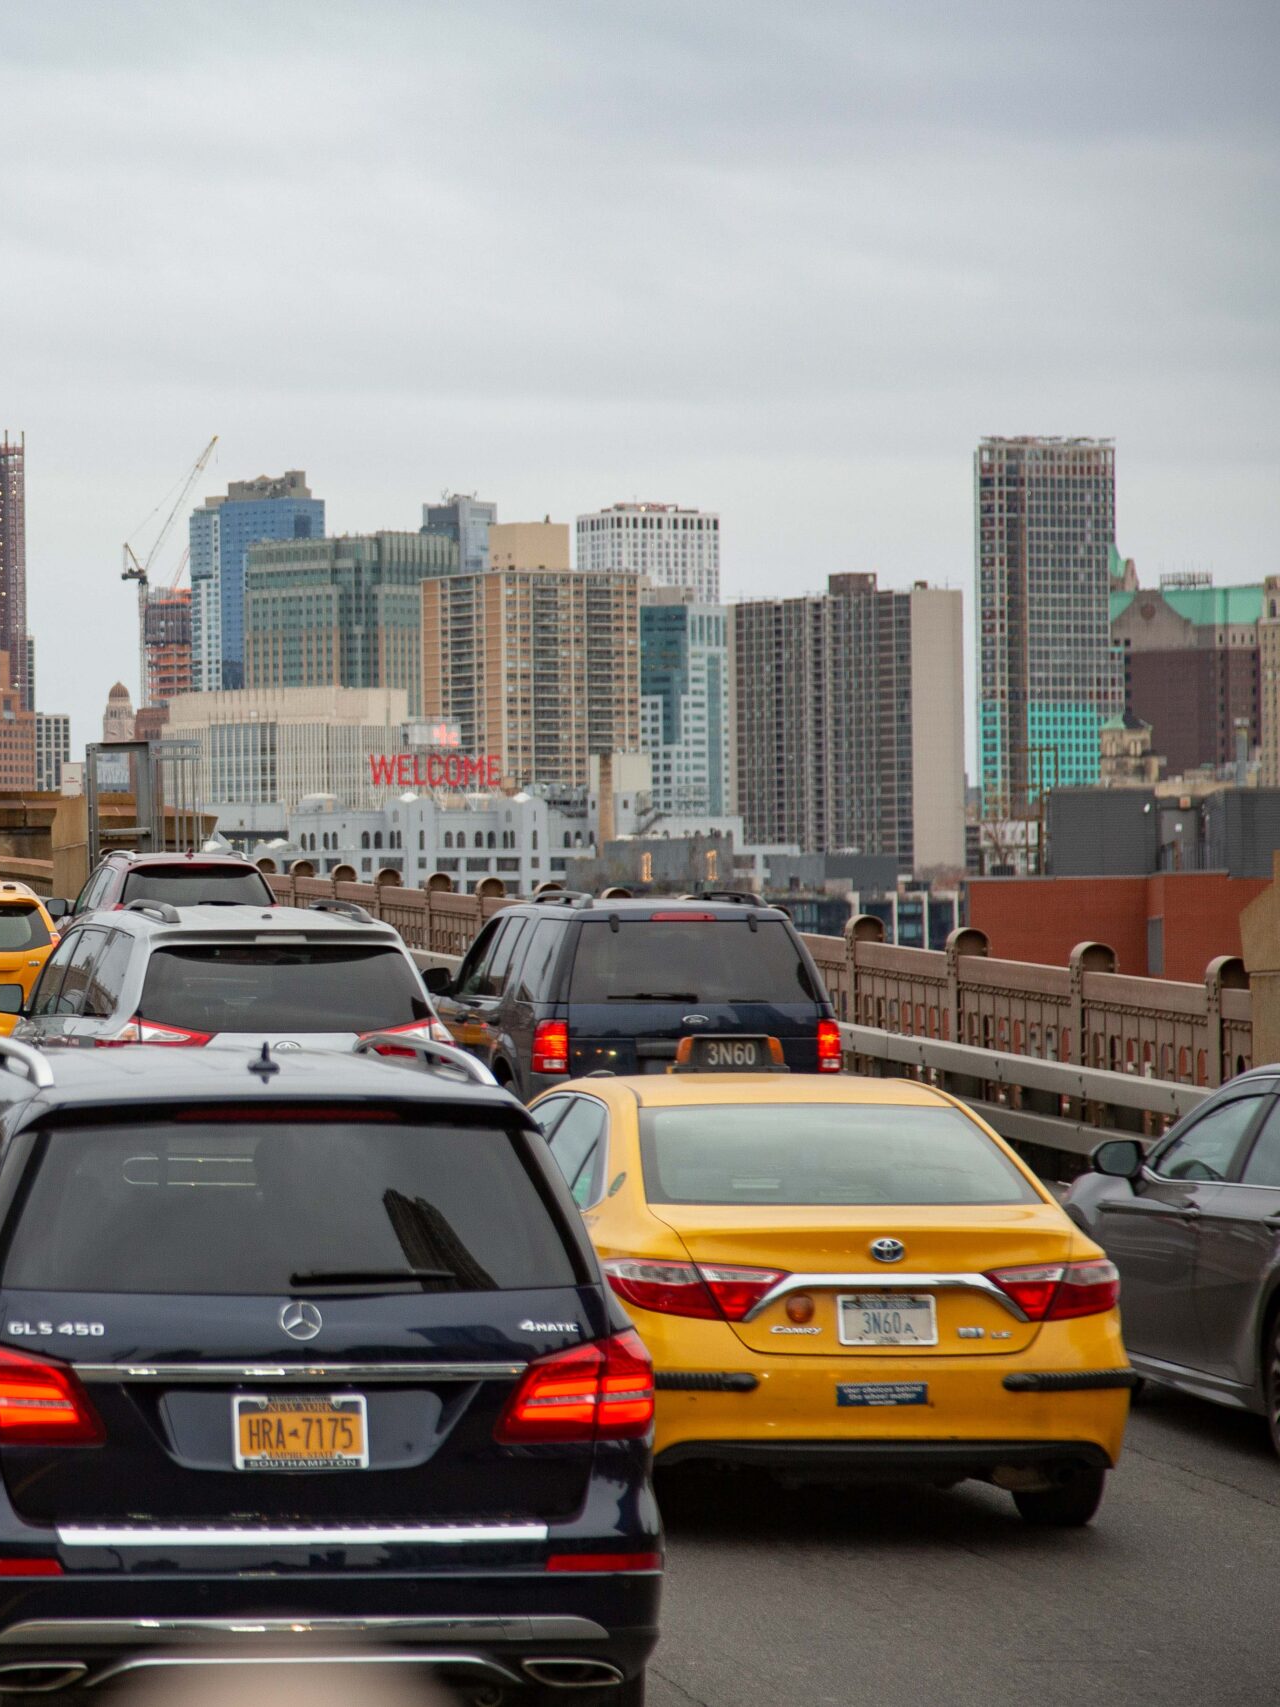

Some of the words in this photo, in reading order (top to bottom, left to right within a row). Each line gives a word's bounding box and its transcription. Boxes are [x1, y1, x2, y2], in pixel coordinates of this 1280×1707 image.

[370, 754, 501, 786] WELCOME
[708, 1043, 756, 1065] 3N60
[8, 1321, 53, 1336] GLS
[59, 1323, 105, 1337] 450
[521, 1319, 578, 1333] 4MATIC
